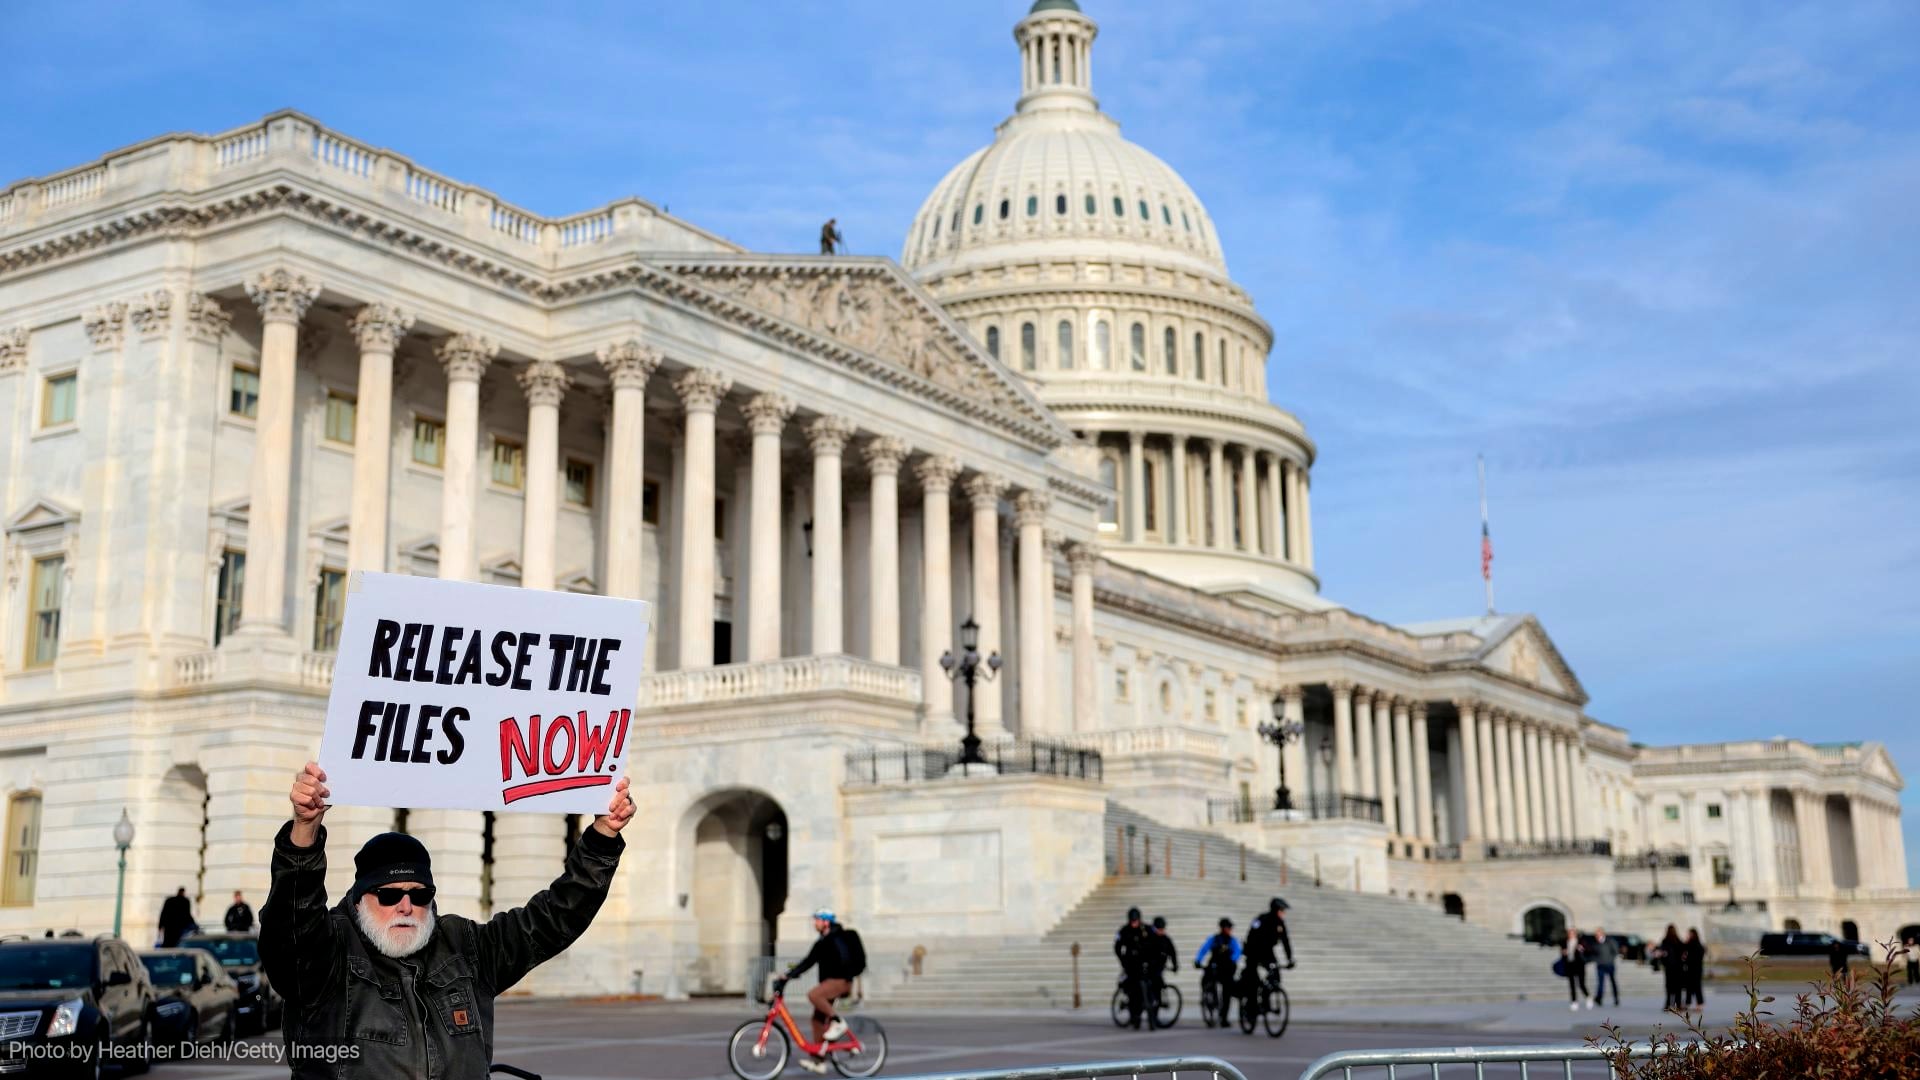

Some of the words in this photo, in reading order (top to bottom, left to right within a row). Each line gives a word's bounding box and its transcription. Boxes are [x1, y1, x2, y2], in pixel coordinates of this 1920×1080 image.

[368, 618, 541, 691] RELEASE
[548, 633, 622, 696] THE
[350, 700, 471, 765] FILES
[499, 708, 632, 782] NOW!
